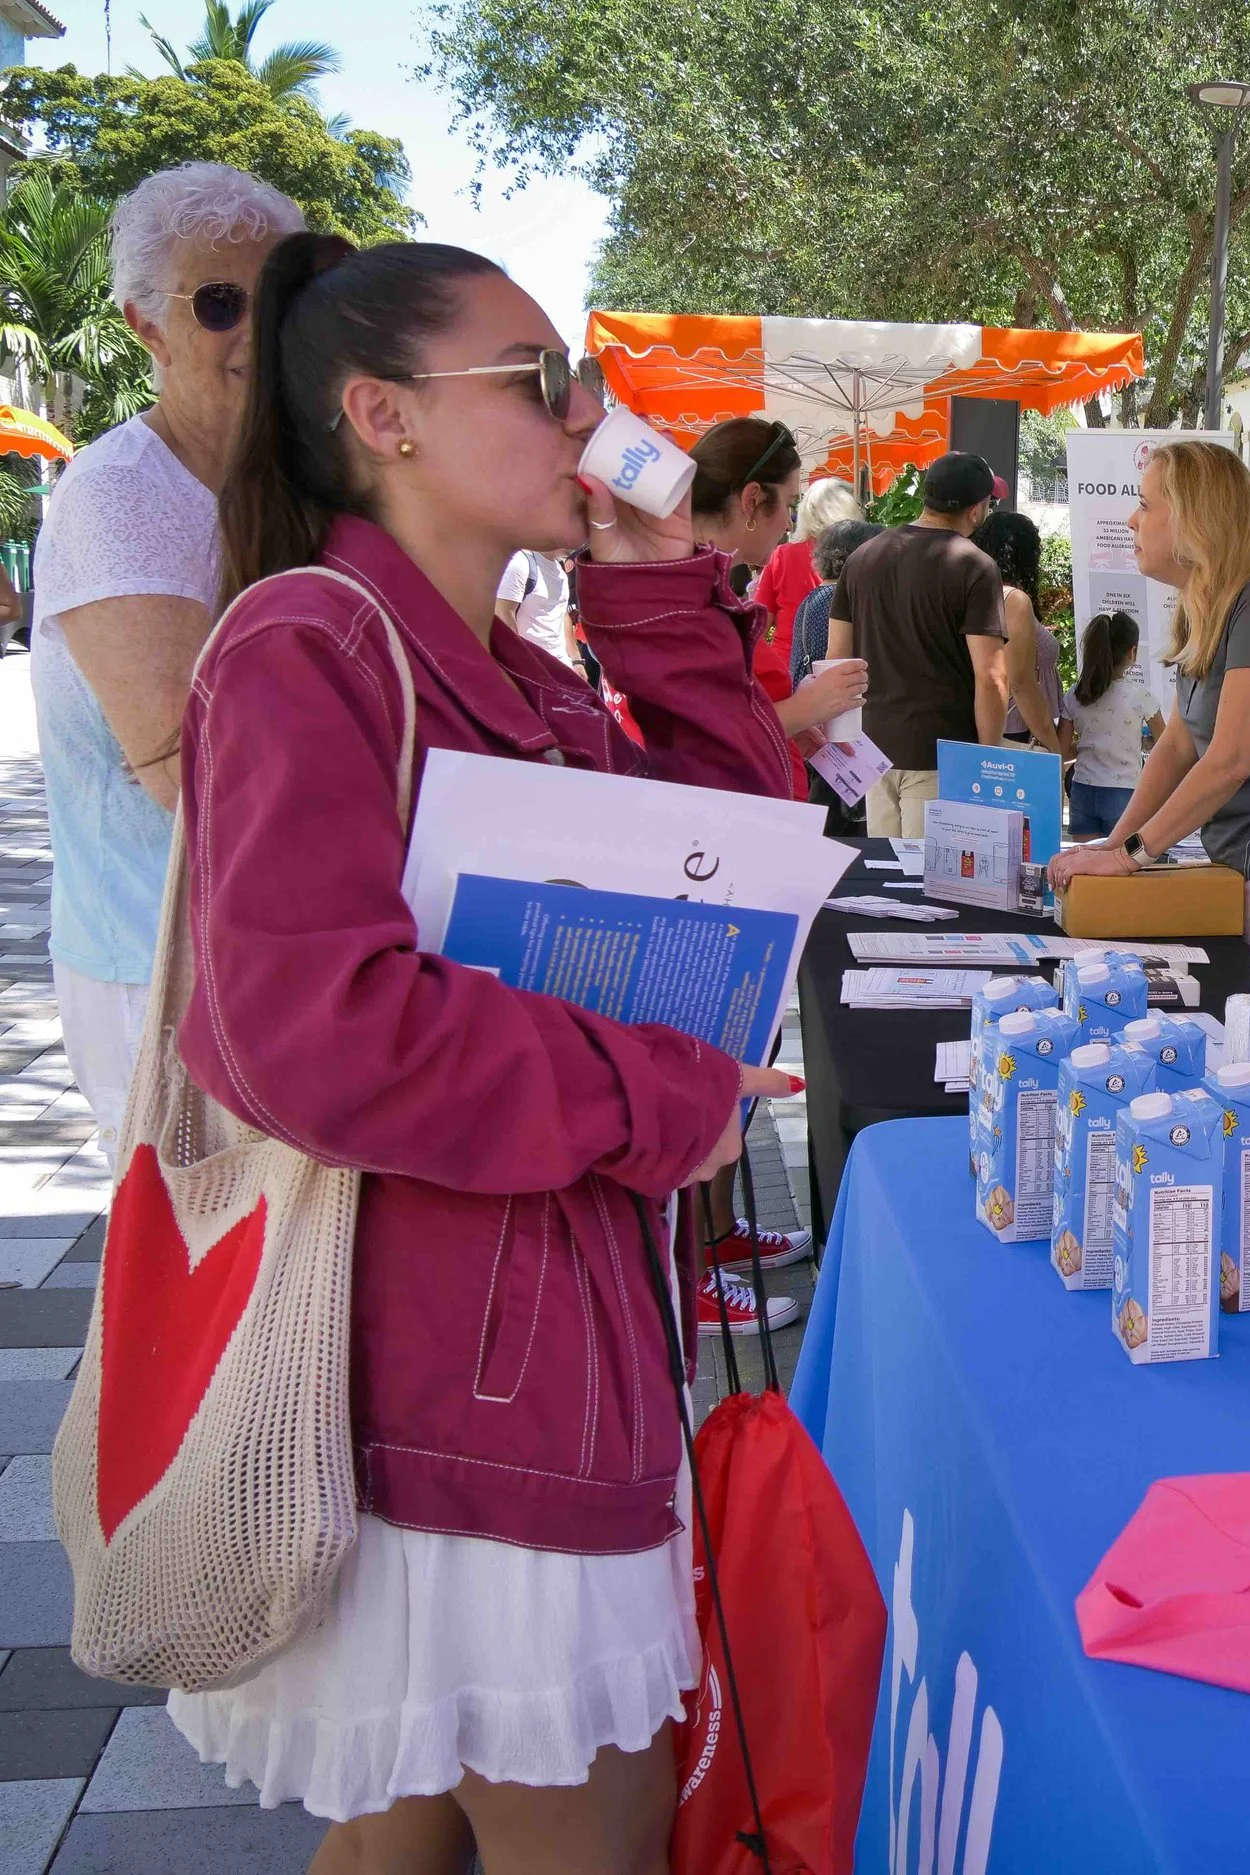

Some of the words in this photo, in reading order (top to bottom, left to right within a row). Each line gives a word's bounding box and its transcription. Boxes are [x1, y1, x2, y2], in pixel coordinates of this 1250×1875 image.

[611, 439, 661, 490] tally
[1078, 483, 1117, 495] FOOD
[1089, 1026, 1109, 1037] tally
[1018, 1077, 1039, 1090] tally
[1088, 1117, 1111, 1130] tally
[1150, 1171, 1175, 1186] tally
